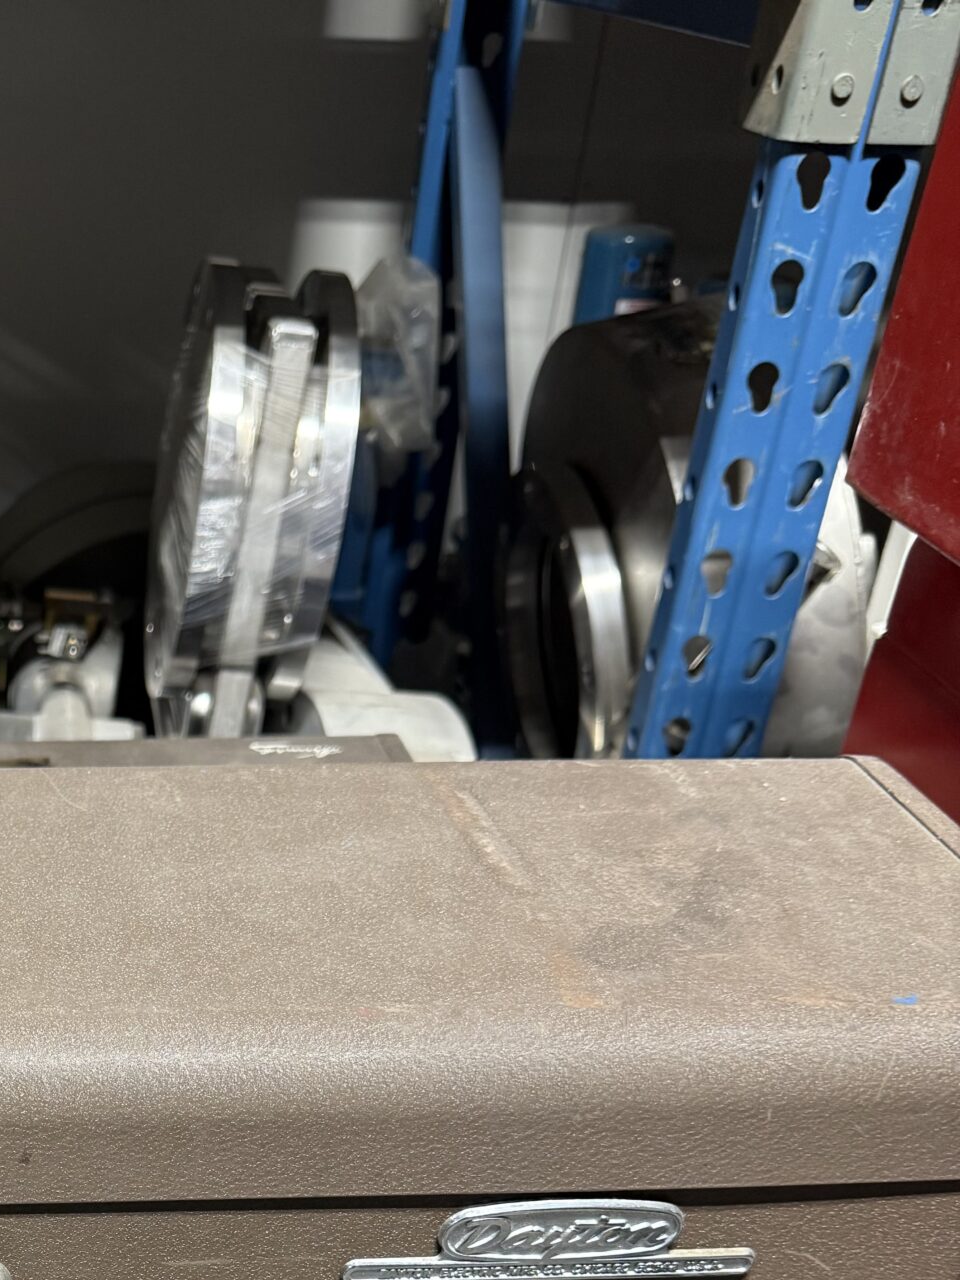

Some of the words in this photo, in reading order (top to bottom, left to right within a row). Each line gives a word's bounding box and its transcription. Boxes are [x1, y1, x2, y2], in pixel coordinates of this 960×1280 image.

[455, 1215, 671, 1259] Dayton
[378, 1267, 433, 1279] DAYTON
[439, 1266, 502, 1279] ELECTRIC
[571, 1263, 631, 1275] CHICAGO
